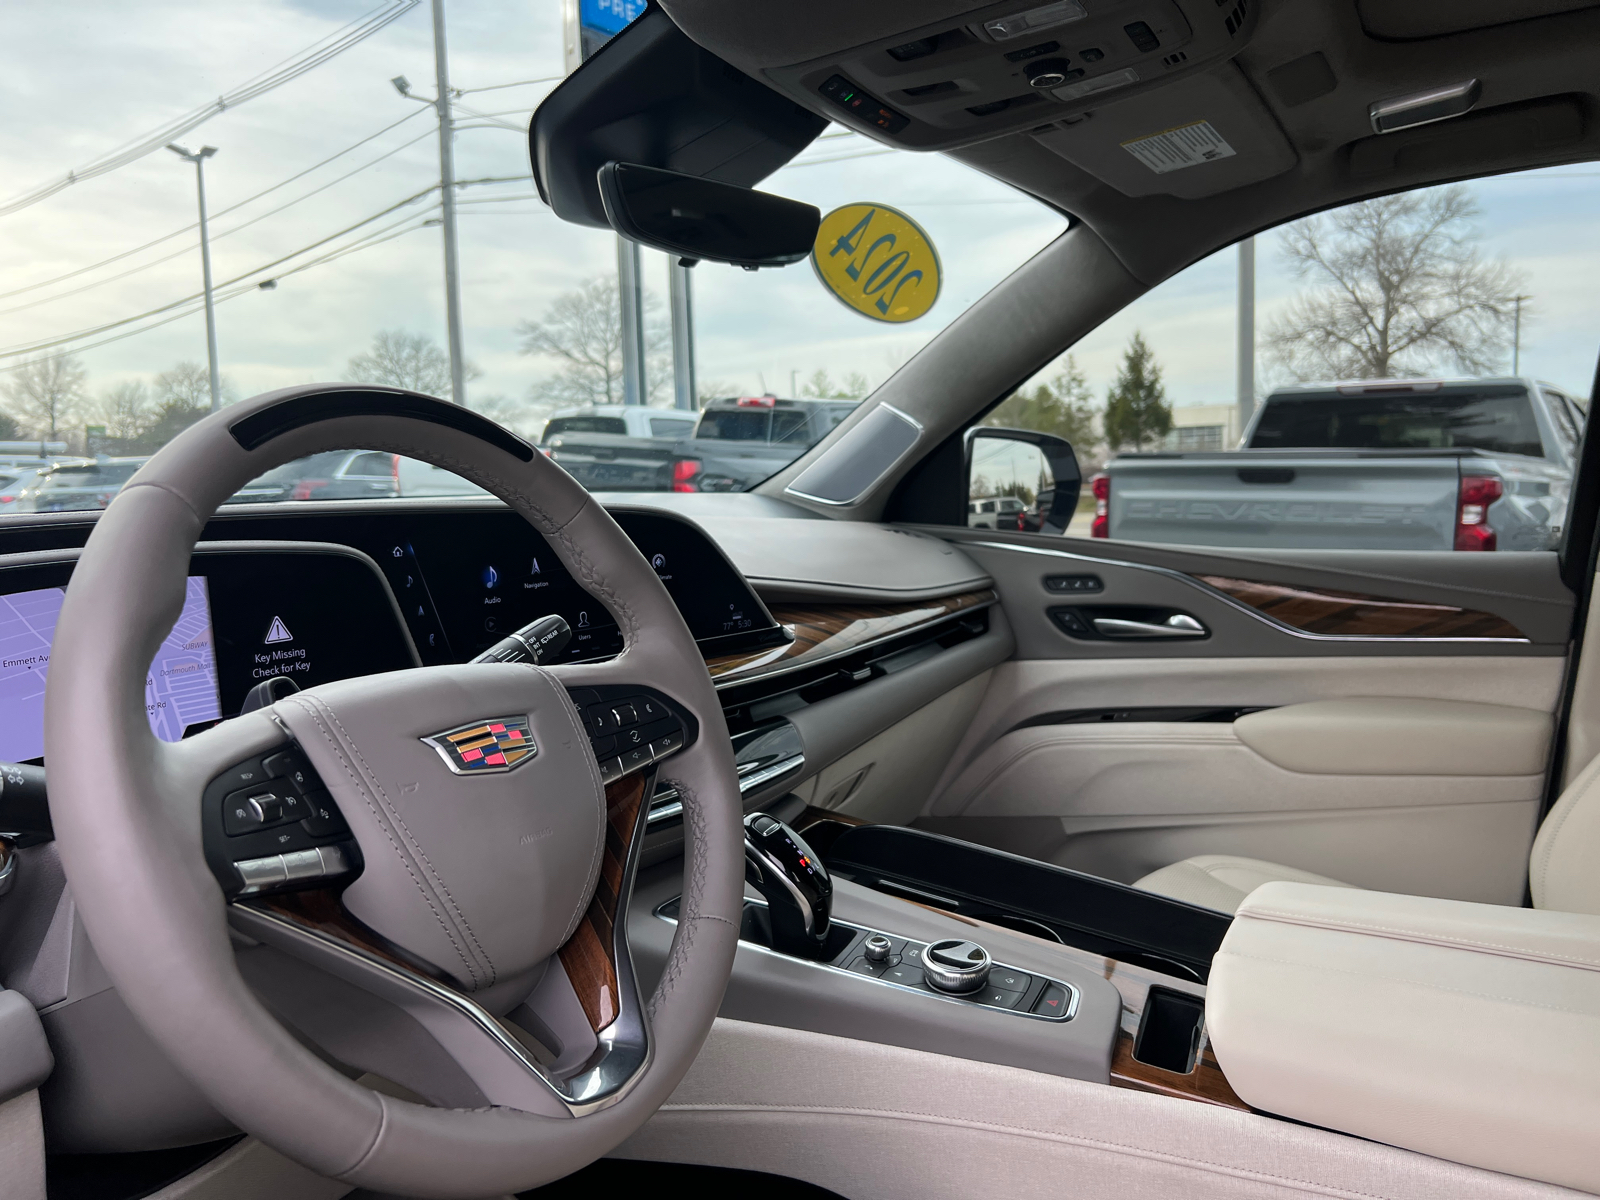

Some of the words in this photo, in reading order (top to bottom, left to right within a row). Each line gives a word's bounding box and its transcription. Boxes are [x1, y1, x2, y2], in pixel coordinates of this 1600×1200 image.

[523, 581, 549, 590] Navigation
[484, 596, 502, 605] Audio
[181, 640, 209, 651] SUBWAY
[2, 656, 37, 668] Emmett
[254, 653, 271, 665] Key
[272, 649, 306, 660] Missing
[160, 665, 195, 676] Dartmouth
[197, 662, 211, 671] Mall
[252, 665, 280, 678] Check
[281, 663, 294, 673] for
[295, 661, 311, 672] Key
[157, 701, 167, 709] Rd
